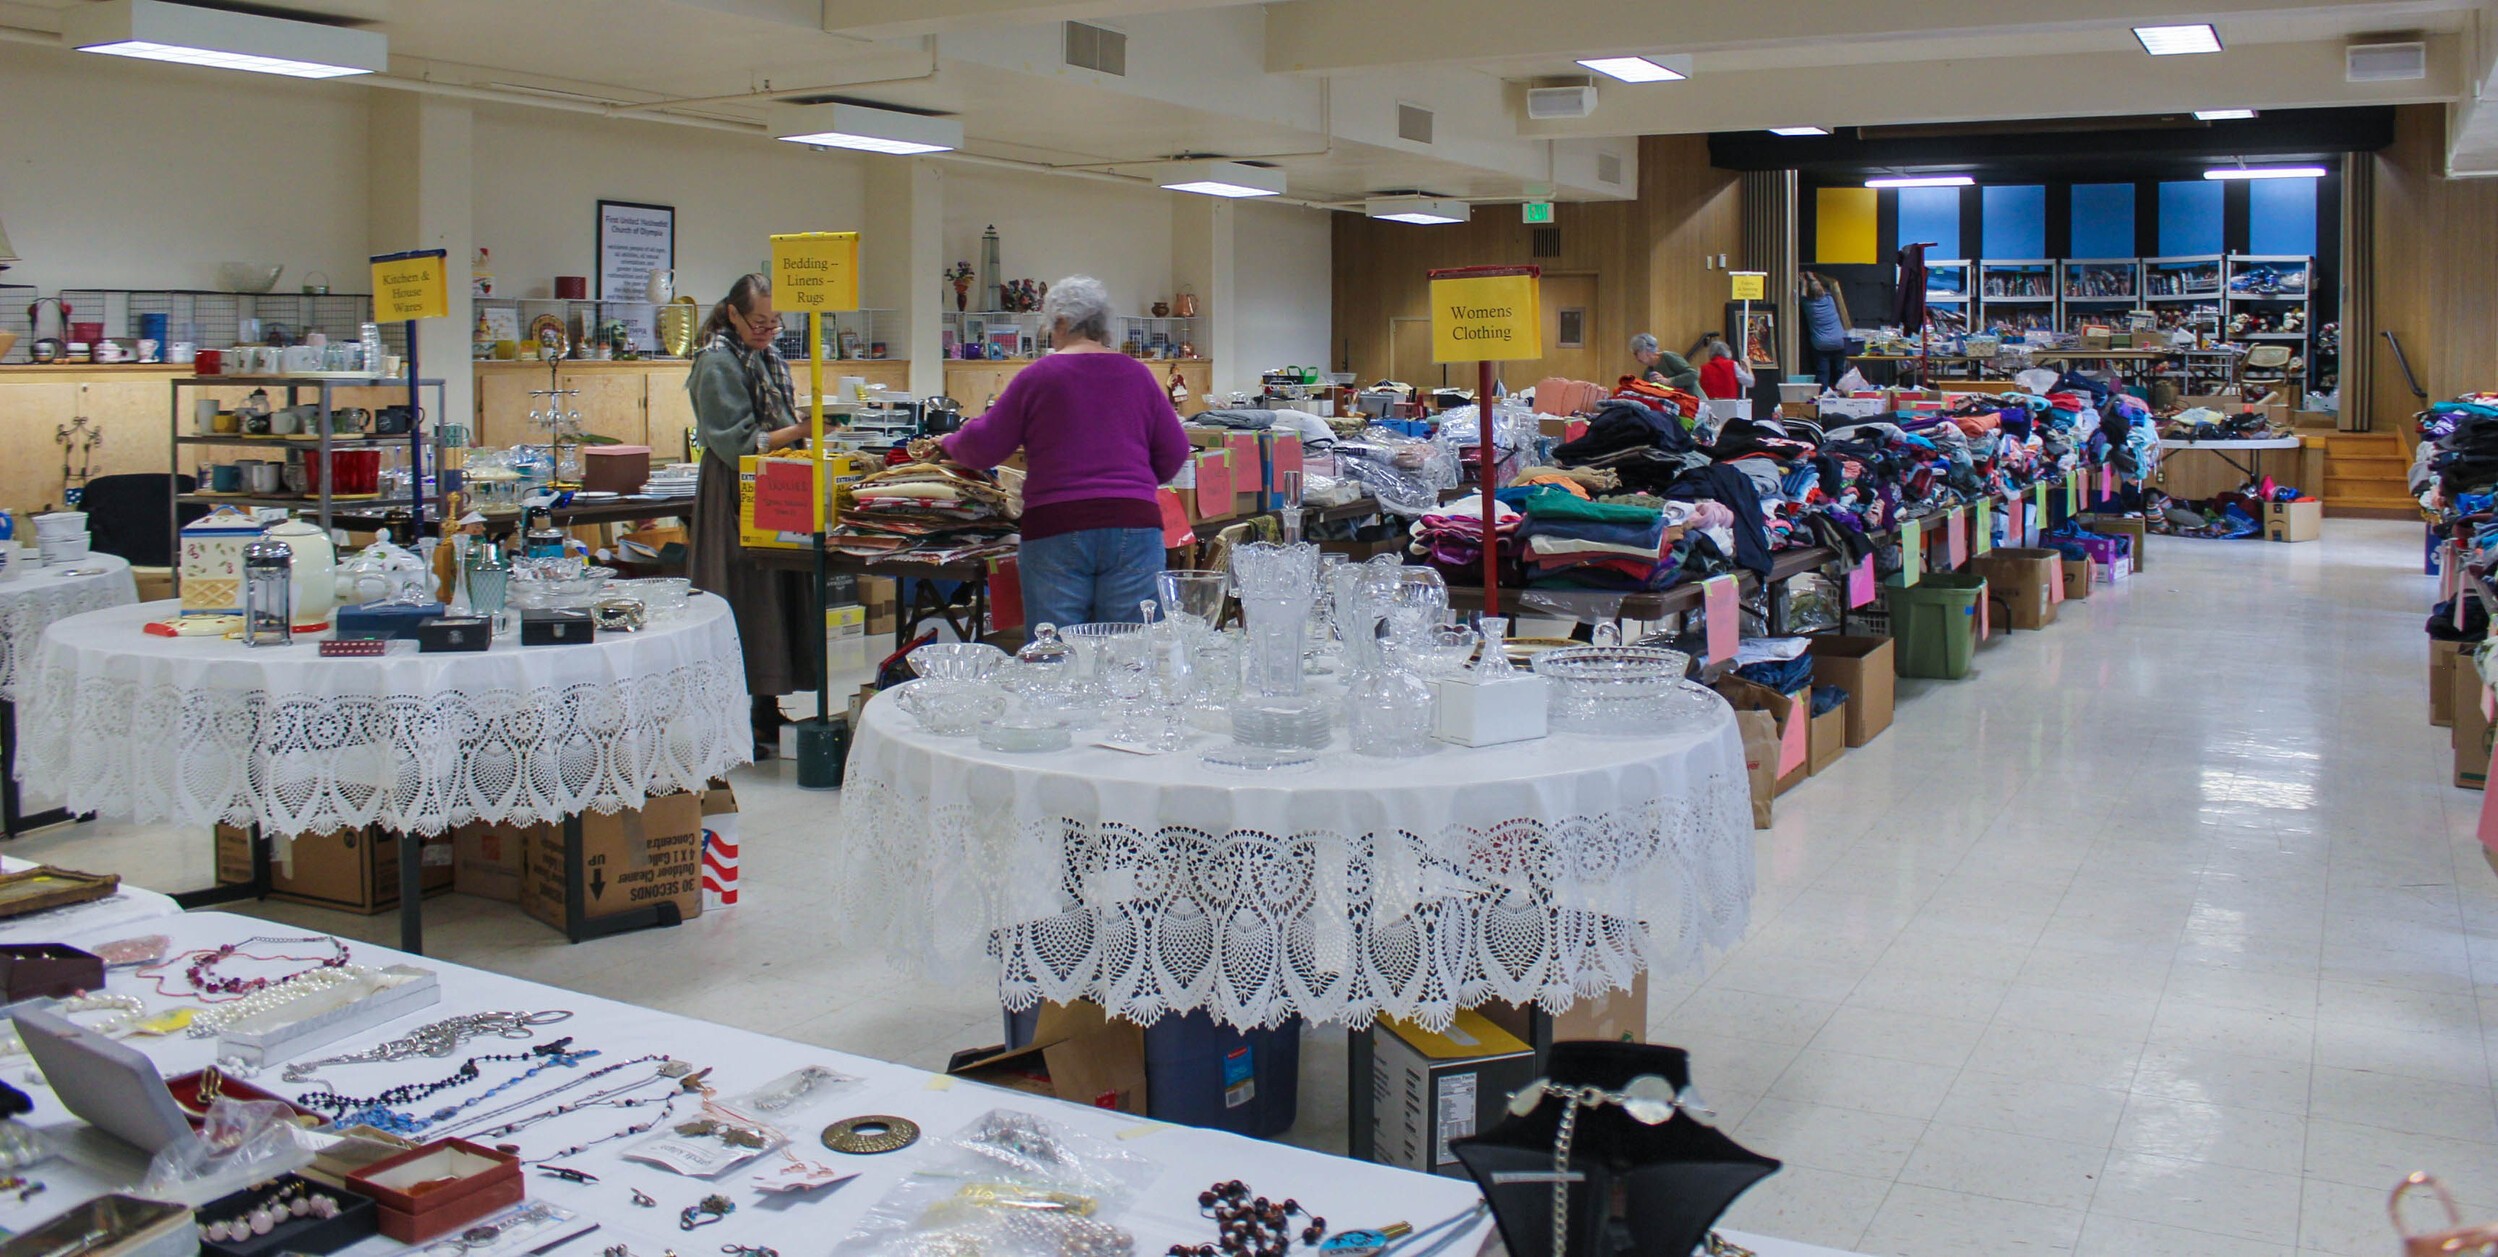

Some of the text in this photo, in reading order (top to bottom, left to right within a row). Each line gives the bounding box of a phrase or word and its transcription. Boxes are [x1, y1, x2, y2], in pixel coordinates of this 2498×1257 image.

[1527, 203, 1549, 221] EXIT
[611, 225, 632, 234] Church
[640, 228, 663, 237] Olympia
[783, 257, 828, 272] Bedding
[382, 270, 431, 286] Kitchen &
[787, 274, 824, 287] Linens
[392, 288, 422, 300] House
[797, 291, 824, 306] Rugs
[394, 302, 423, 314] Wares
[1451, 304, 1513, 320] Womens
[1453, 325, 1511, 342] Clothing
[646, 833, 695, 849] Concentra
[588, 854, 606, 867] UP
[673, 852, 679, 863] 1
[681, 851, 687, 863] X
[689, 849, 695, 861] 4
[617, 862, 695, 884] Outdoor Cleaner
[630, 878, 695, 902] 30 SECONDS
